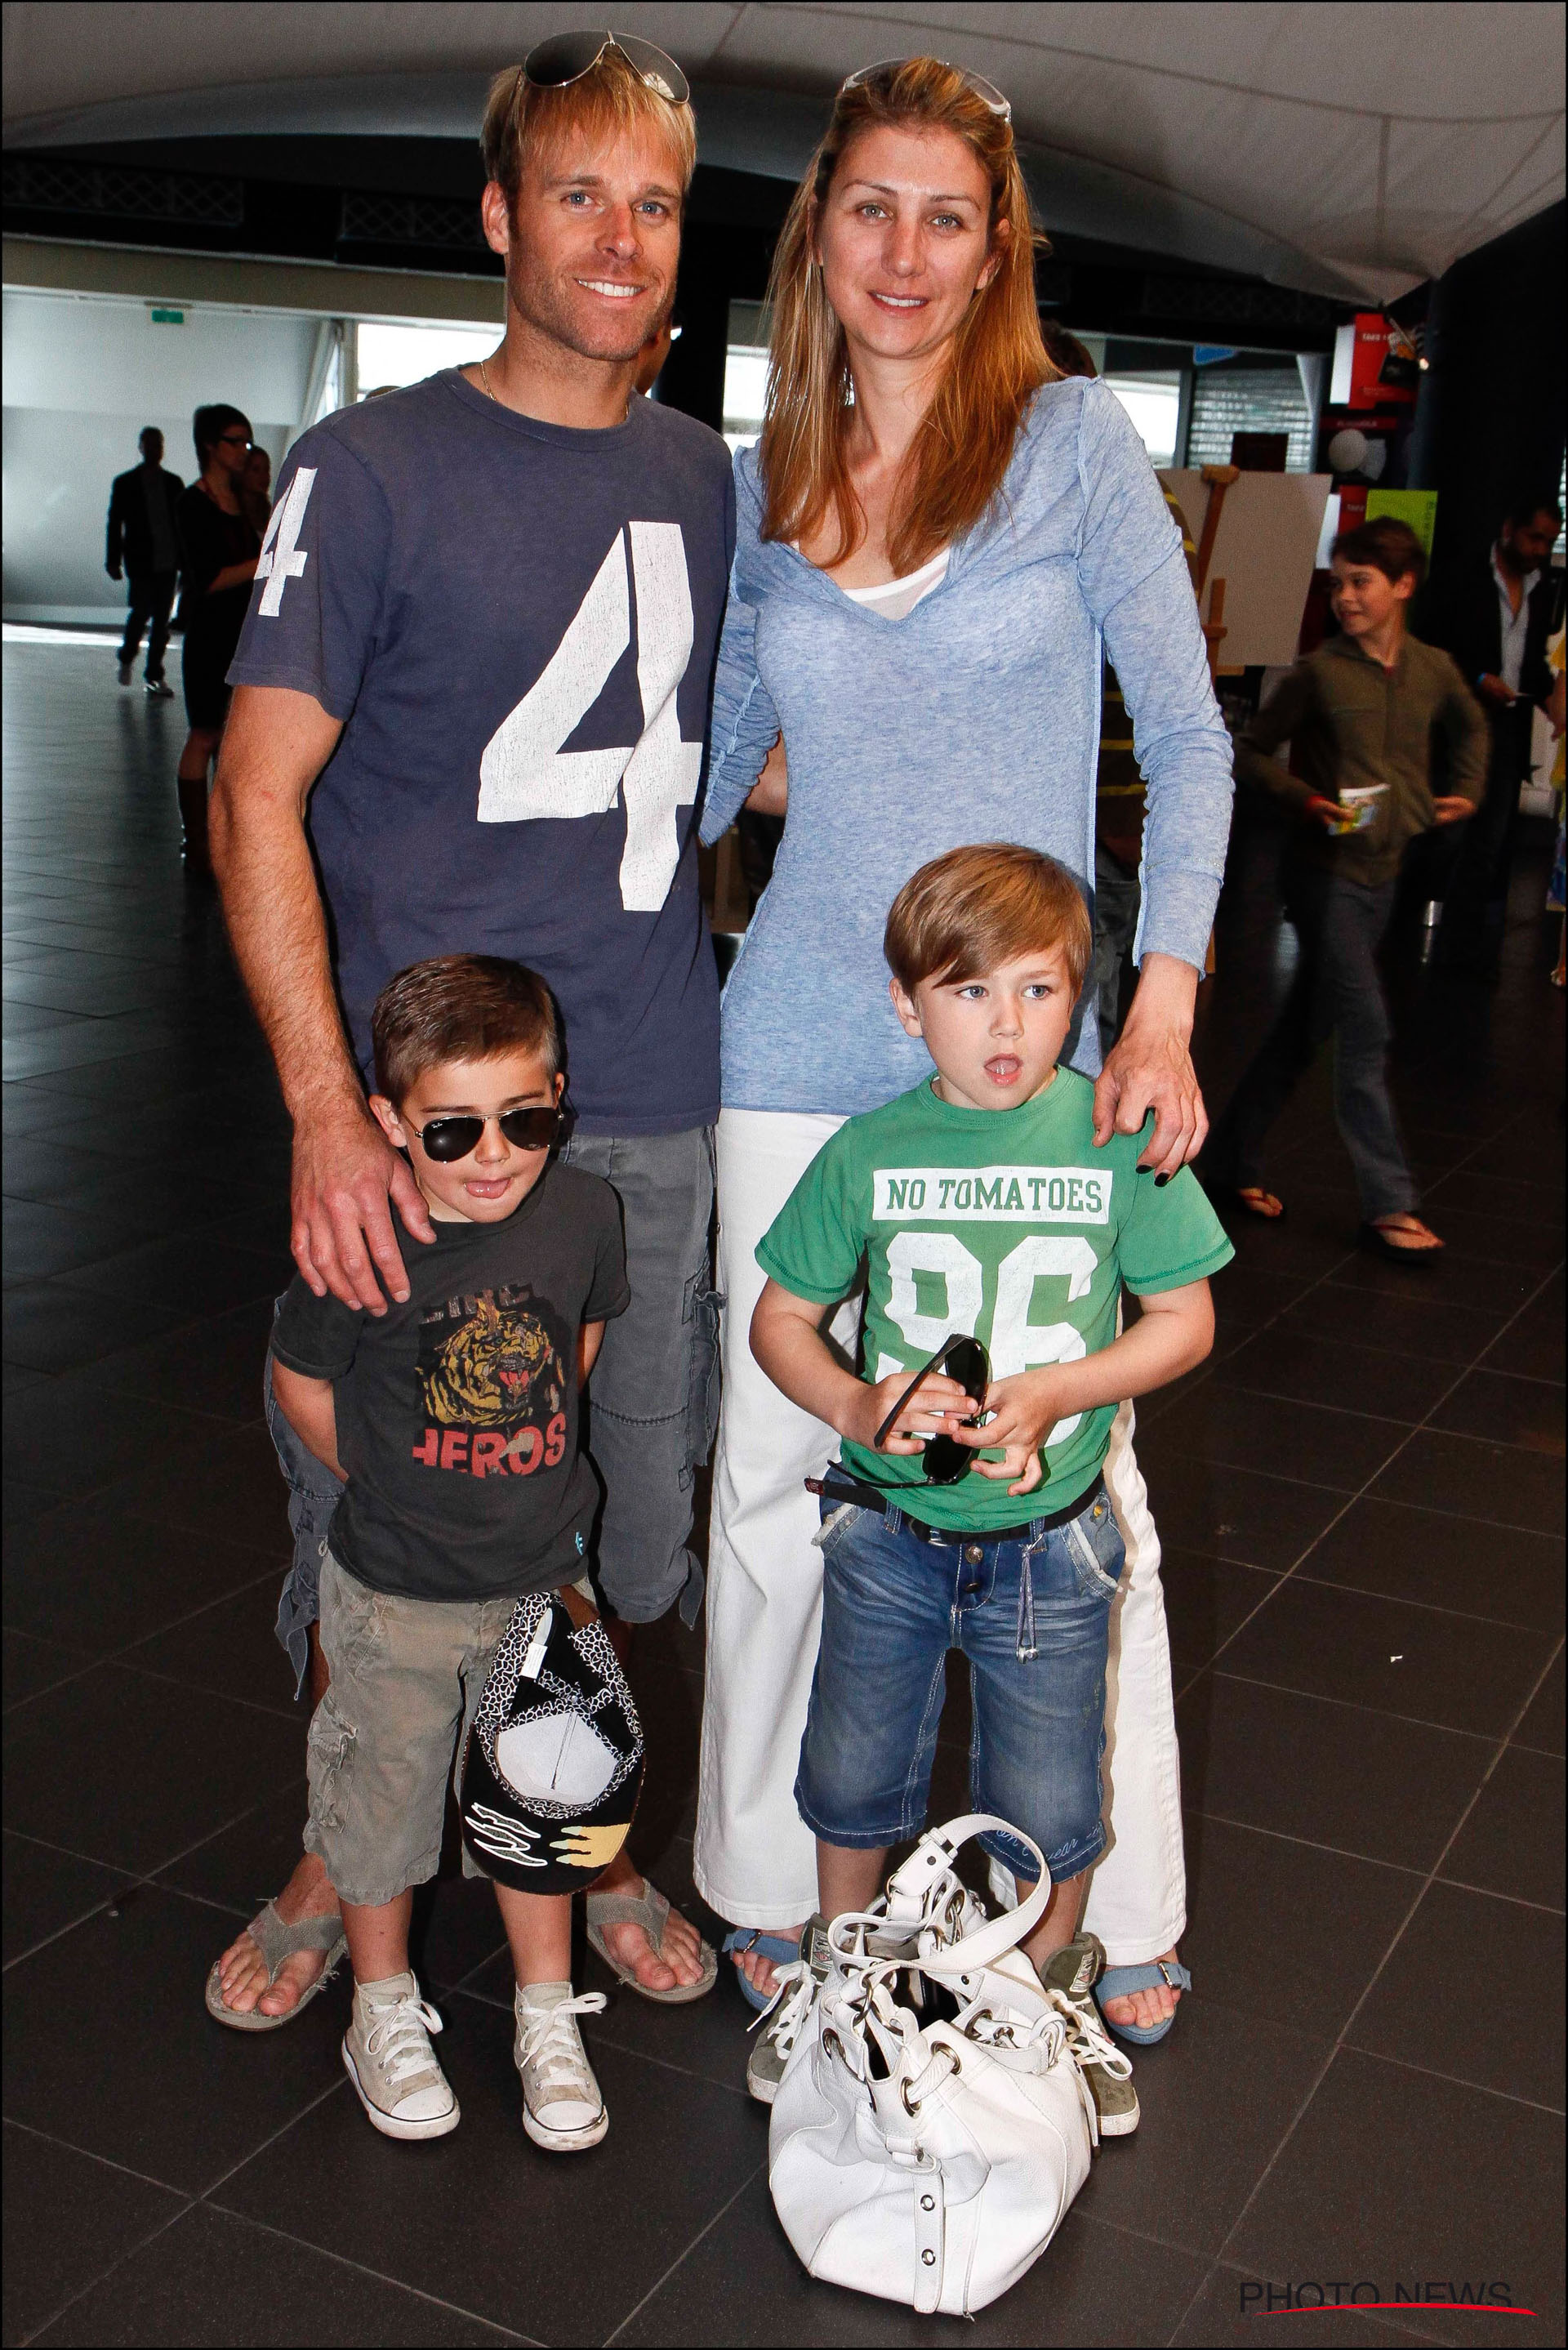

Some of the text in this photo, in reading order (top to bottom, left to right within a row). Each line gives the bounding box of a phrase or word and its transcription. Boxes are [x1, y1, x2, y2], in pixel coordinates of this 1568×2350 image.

[253, 466, 318, 618] 4
[477, 521, 703, 912] 4
[886, 1177, 1102, 1213] NO TOMATOES
[875, 1232, 1098, 1449] 96
[412, 1411, 567, 1479] HEROS
